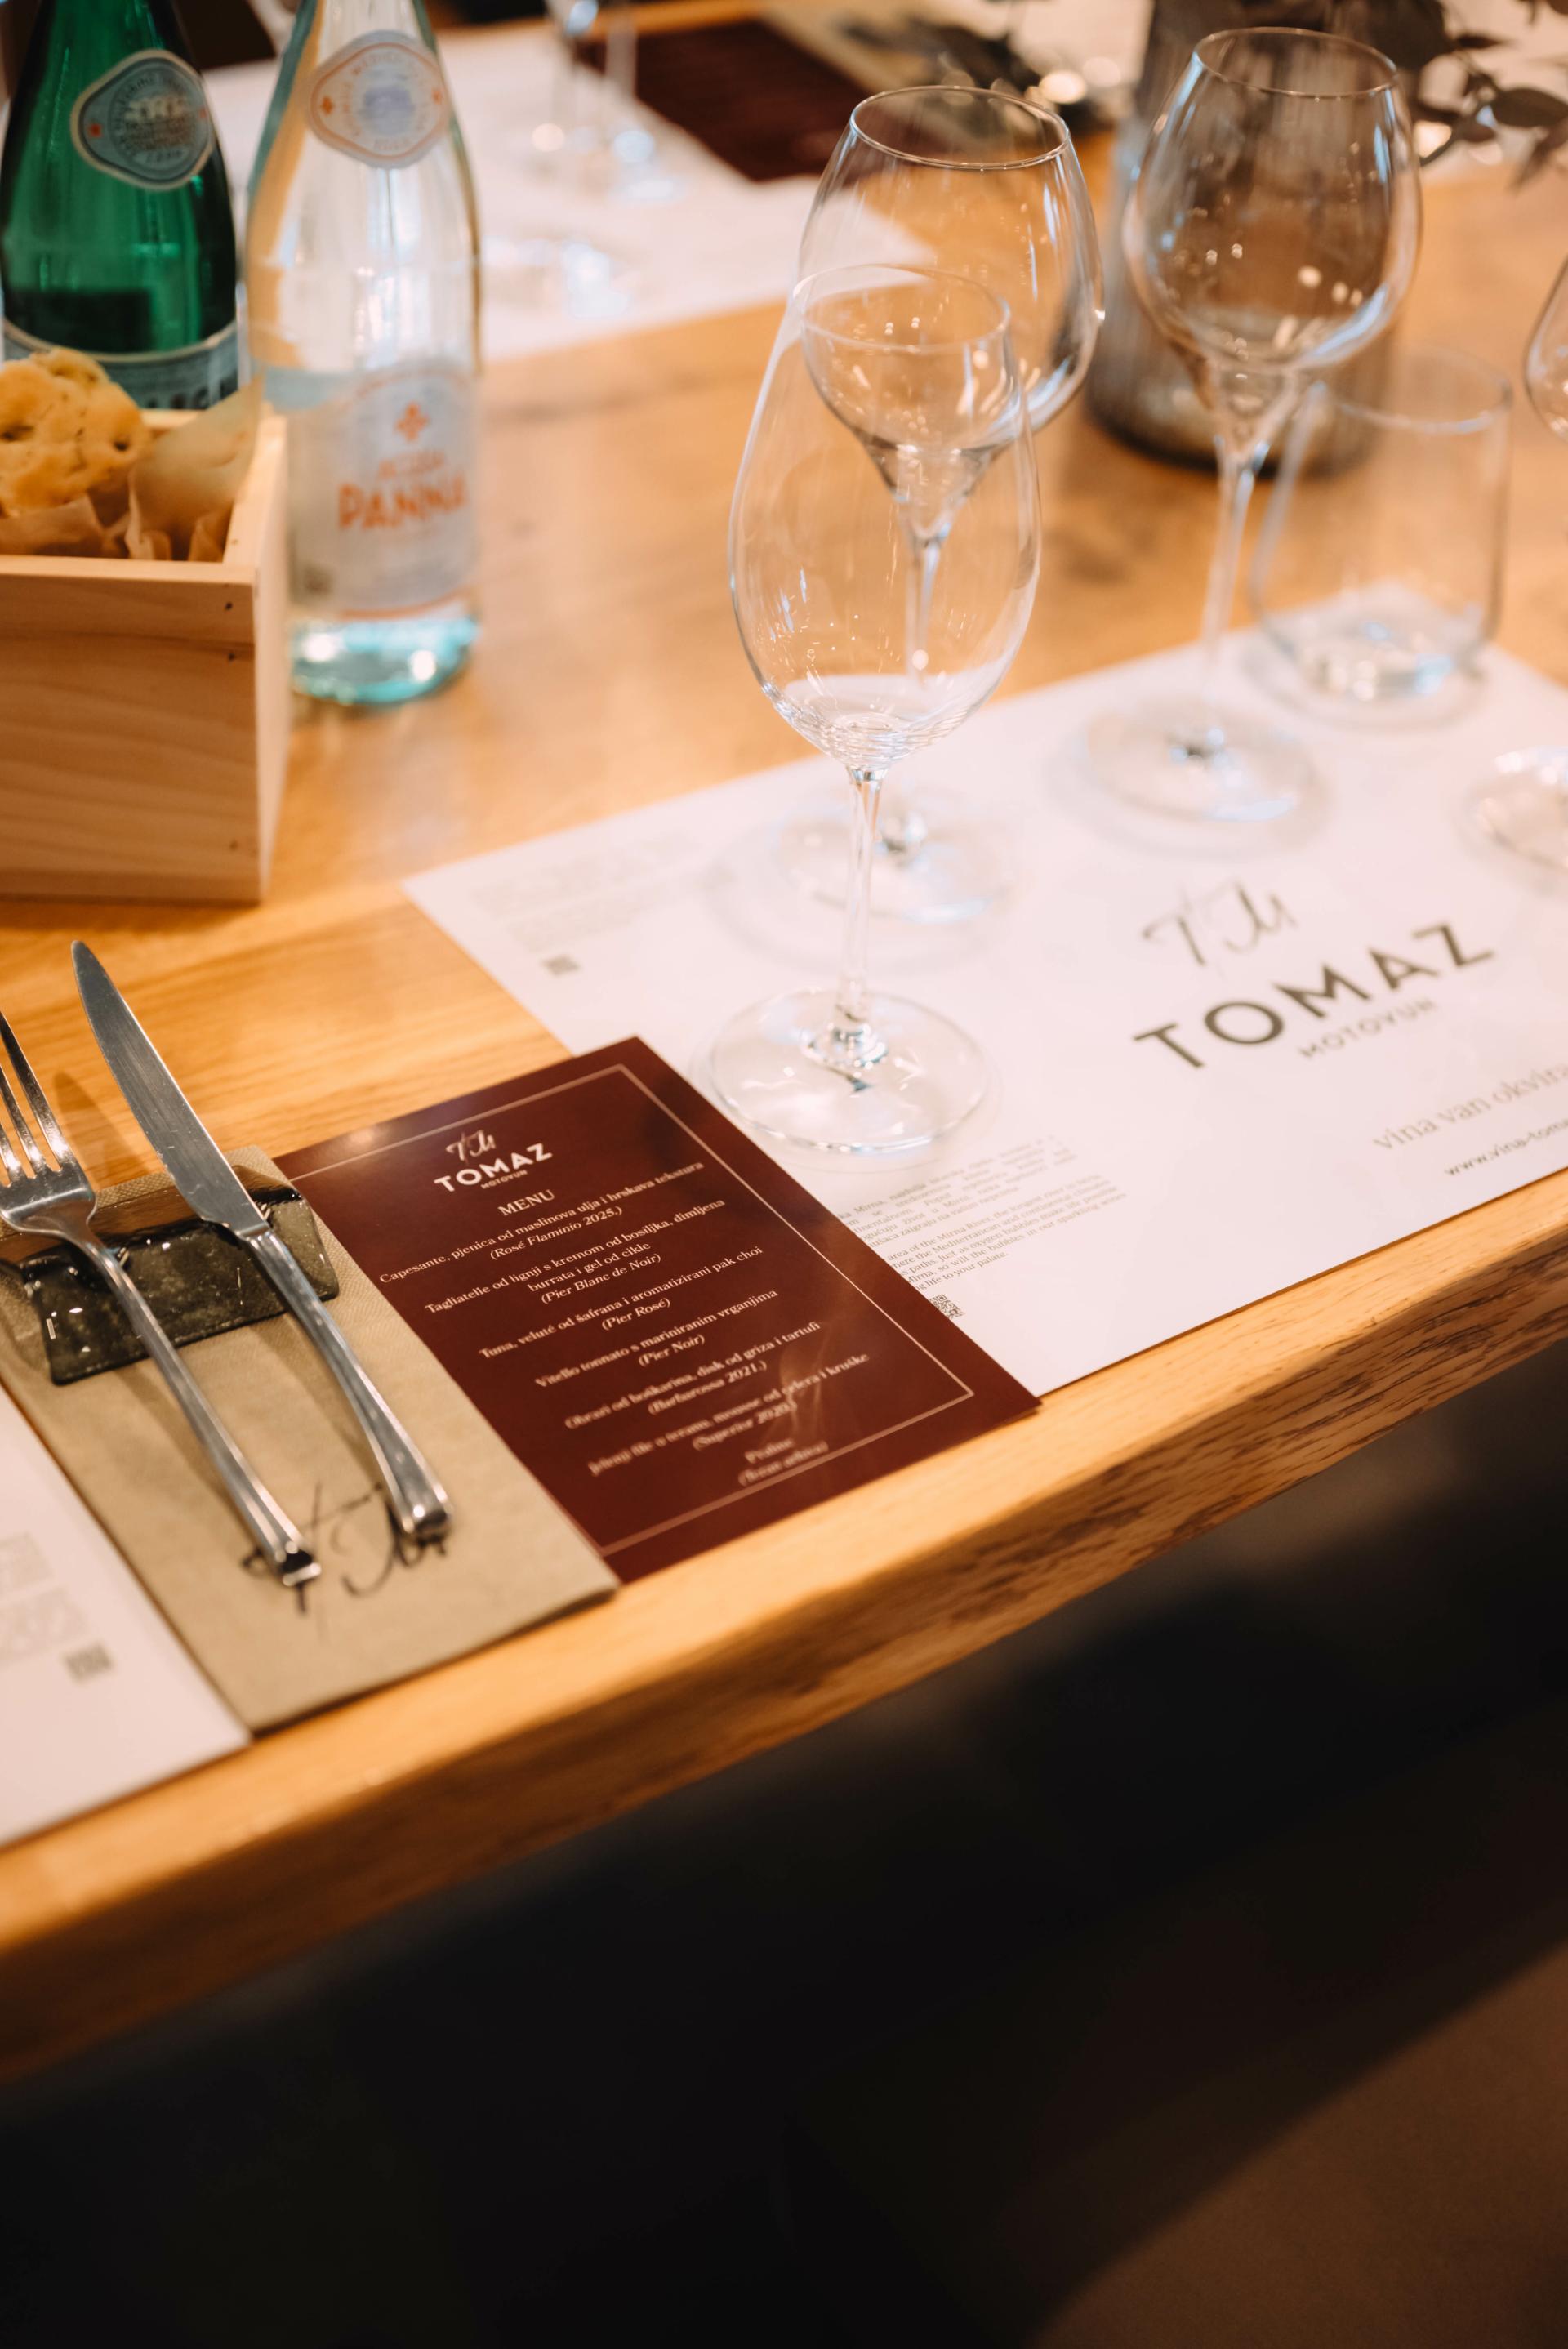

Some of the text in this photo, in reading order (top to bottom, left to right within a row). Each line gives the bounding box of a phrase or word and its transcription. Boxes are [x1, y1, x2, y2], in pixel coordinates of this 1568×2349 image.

[1133, 921, 1497, 1069] TOMAZ
[1373, 1117, 1439, 1152] vina
[1437, 1094, 1492, 1125] van
[434, 1143, 552, 1192] TOMAZ
[481, 1170, 528, 1189] MOTOVUN
[380, 1256, 450, 1282] Capesante,
[451, 1239, 496, 1259] pjenica
[497, 1230, 514, 1241] od
[515, 1210, 577, 1235] maslinova
[577, 1201, 601, 1212] ulja
[606, 1181, 655, 1201] hrskava
[654, 1162, 703, 1183] tekstura
[498, 1190, 555, 1215] MENU
[490, 1206, 622, 1259] (Rosé Flaminio 2025.)
[889, 1250, 909, 1260] area
[909, 1244, 920, 1252] of
[920, 1239, 936, 1247] the
[936, 1228, 967, 1241] Mirna
[425, 1287, 490, 1313] Tagliatelle
[492, 1277, 509, 1289] od
[509, 1266, 542, 1282] lignji
[550, 1246, 604, 1267] kremom
[606, 1237, 622, 1247] od
[621, 1221, 673, 1241] bosiljka,
[674, 1201, 725, 1223] dimljena
[527, 1272, 575, 1291] burrata
[584, 1259, 603, 1273] gel
[604, 1253, 621, 1264] od
[621, 1244, 650, 1257] cikle
[541, 1254, 661, 1304] (Pier Blanc de Noir)
[891, 1258, 915, 1268] here
[915, 1251, 931, 1259] the
[924, 1277, 942, 1286] life
[953, 1264, 976, 1277] your
[950, 1255, 969, 1266] will
[970, 1250, 986, 1258] the
[479, 1343, 517, 1357] Tuna,
[518, 1325, 555, 1344] veluté
[558, 1317, 575, 1329] od
[576, 1302, 623, 1322] šafrana
[631, 1266, 711, 1302] aromatizirani
[712, 1258, 736, 1272] pak
[737, 1246, 763, 1261] choi
[602, 1298, 670, 1330] (Pier Rosé)
[640, 1315, 717, 1348] mariniranim
[717, 1290, 777, 1317] vrganjima
[725, 1353, 742, 1365] od
[743, 1342, 775, 1359] griza
[782, 1322, 820, 1342] tartufi
